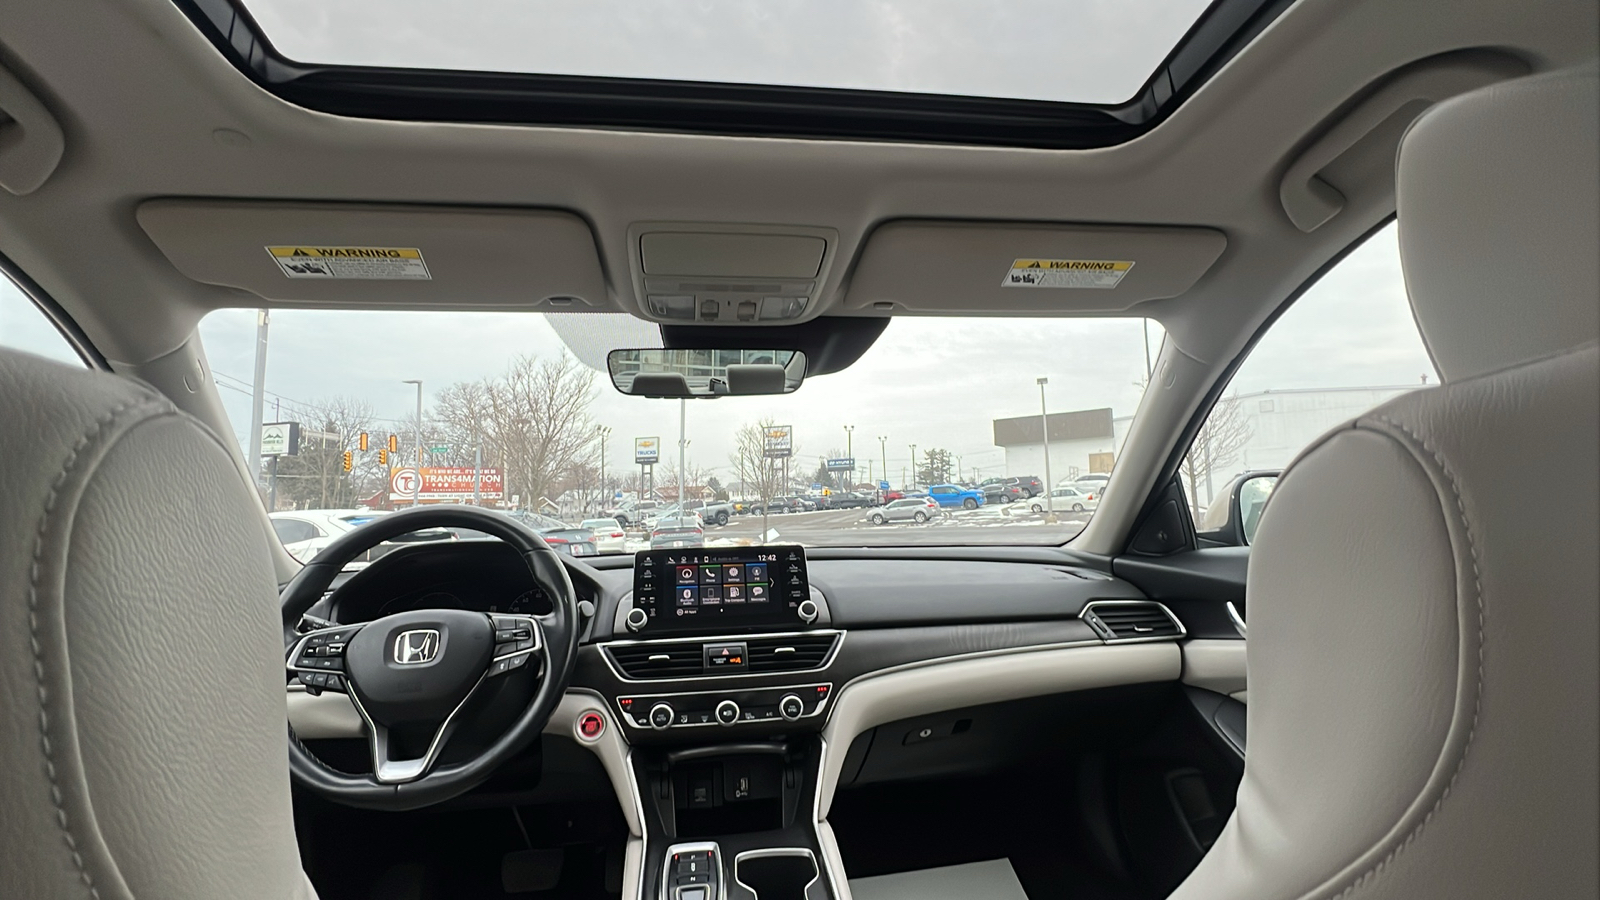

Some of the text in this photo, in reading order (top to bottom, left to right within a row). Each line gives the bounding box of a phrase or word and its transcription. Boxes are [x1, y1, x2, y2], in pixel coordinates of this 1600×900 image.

[315, 248, 401, 258] WARNING
[1050, 261, 1114, 270] WARNING
[425, 475, 501, 483] TRANS4MATION
[758, 554, 777, 562] 12:42
